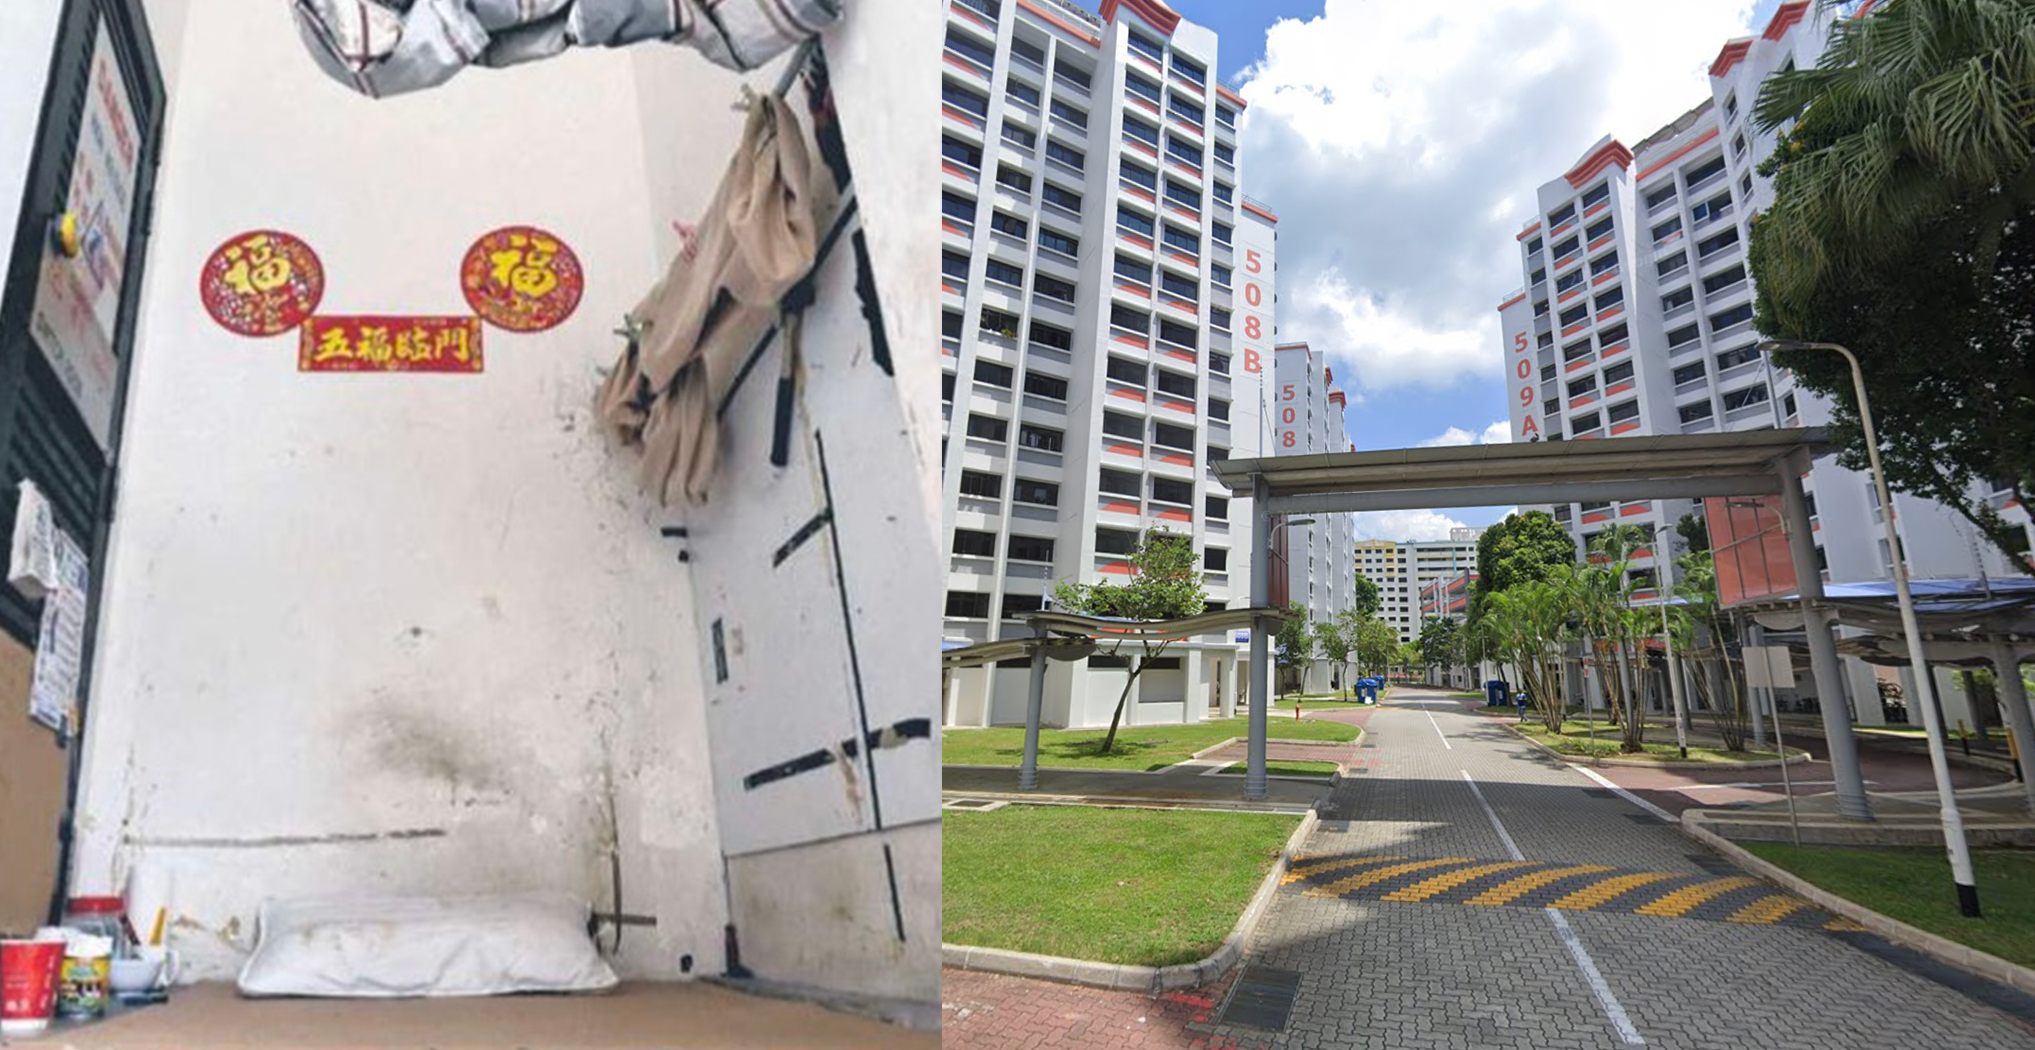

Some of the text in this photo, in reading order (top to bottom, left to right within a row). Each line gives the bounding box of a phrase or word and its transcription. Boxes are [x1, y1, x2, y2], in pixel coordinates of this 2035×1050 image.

[224, 235, 291, 294] 福
[490, 234, 557, 297] 福
[1244, 249, 1262, 374] 508B
[1515, 331, 1538, 436] 509A
[1282, 384, 1295, 448] 508
